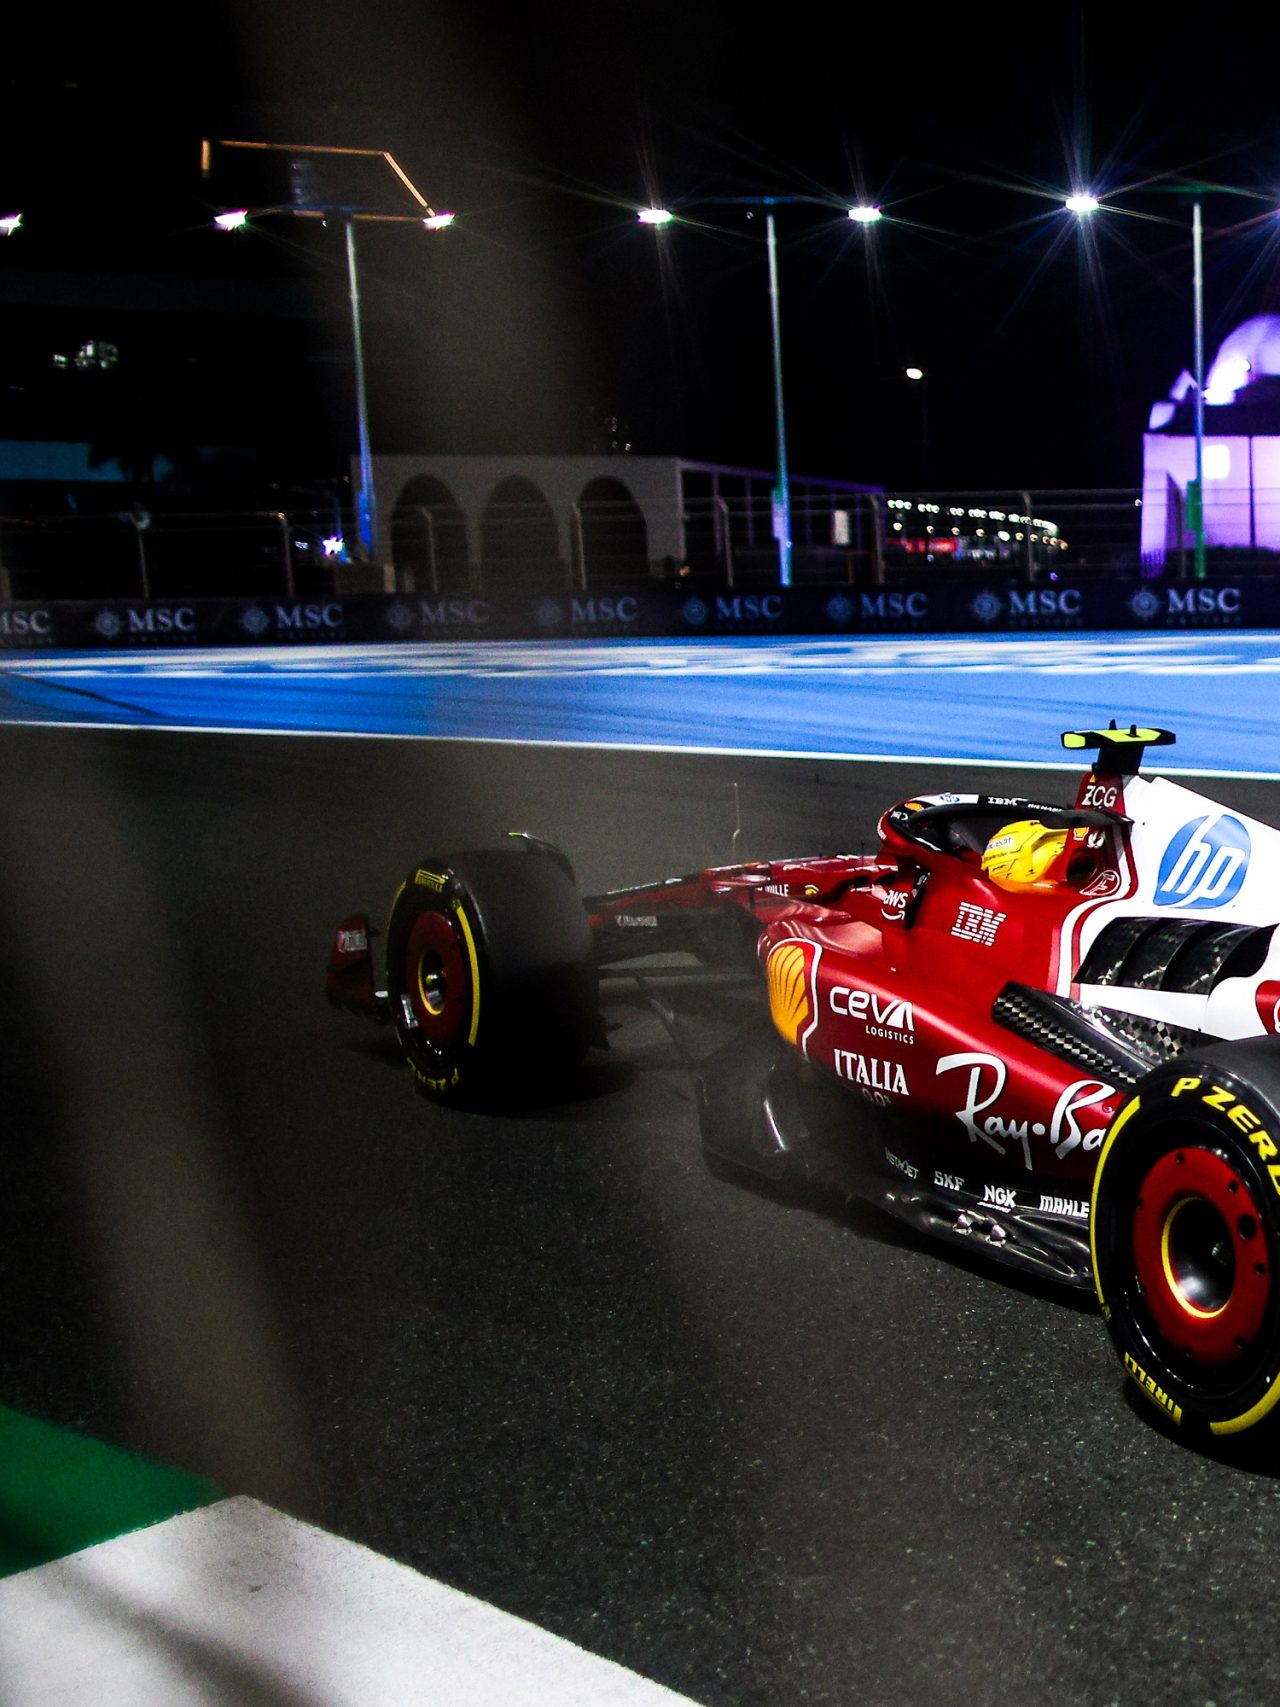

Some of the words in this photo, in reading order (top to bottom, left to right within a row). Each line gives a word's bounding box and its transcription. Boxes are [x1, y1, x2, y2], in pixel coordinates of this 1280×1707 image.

[571, 597, 638, 622] MSC
[715, 595, 783, 620] MSC
[859, 592, 928, 618] MSC
[1008, 589, 1081, 615] MSC
[1167, 587, 1241, 612] MSC
[127, 607, 197, 632] MSC
[274, 604, 344, 629] MSC
[419, 600, 490, 625] MSC
[988, 796, 1017, 806] IBM
[1157, 815, 1247, 907] hp
[951, 901, 1006, 947] IBM
[866, 1025, 914, 1044] LOGISTICS
[833, 1048, 909, 1096] ITALIA
[1170, 1076, 1202, 1098] P
[936, 1052, 1116, 1170] Ray-Ba
[934, 1170, 966, 1192] SKF
[983, 1184, 1017, 1208] NGK
[1039, 1194, 1090, 1219] MAHLE
